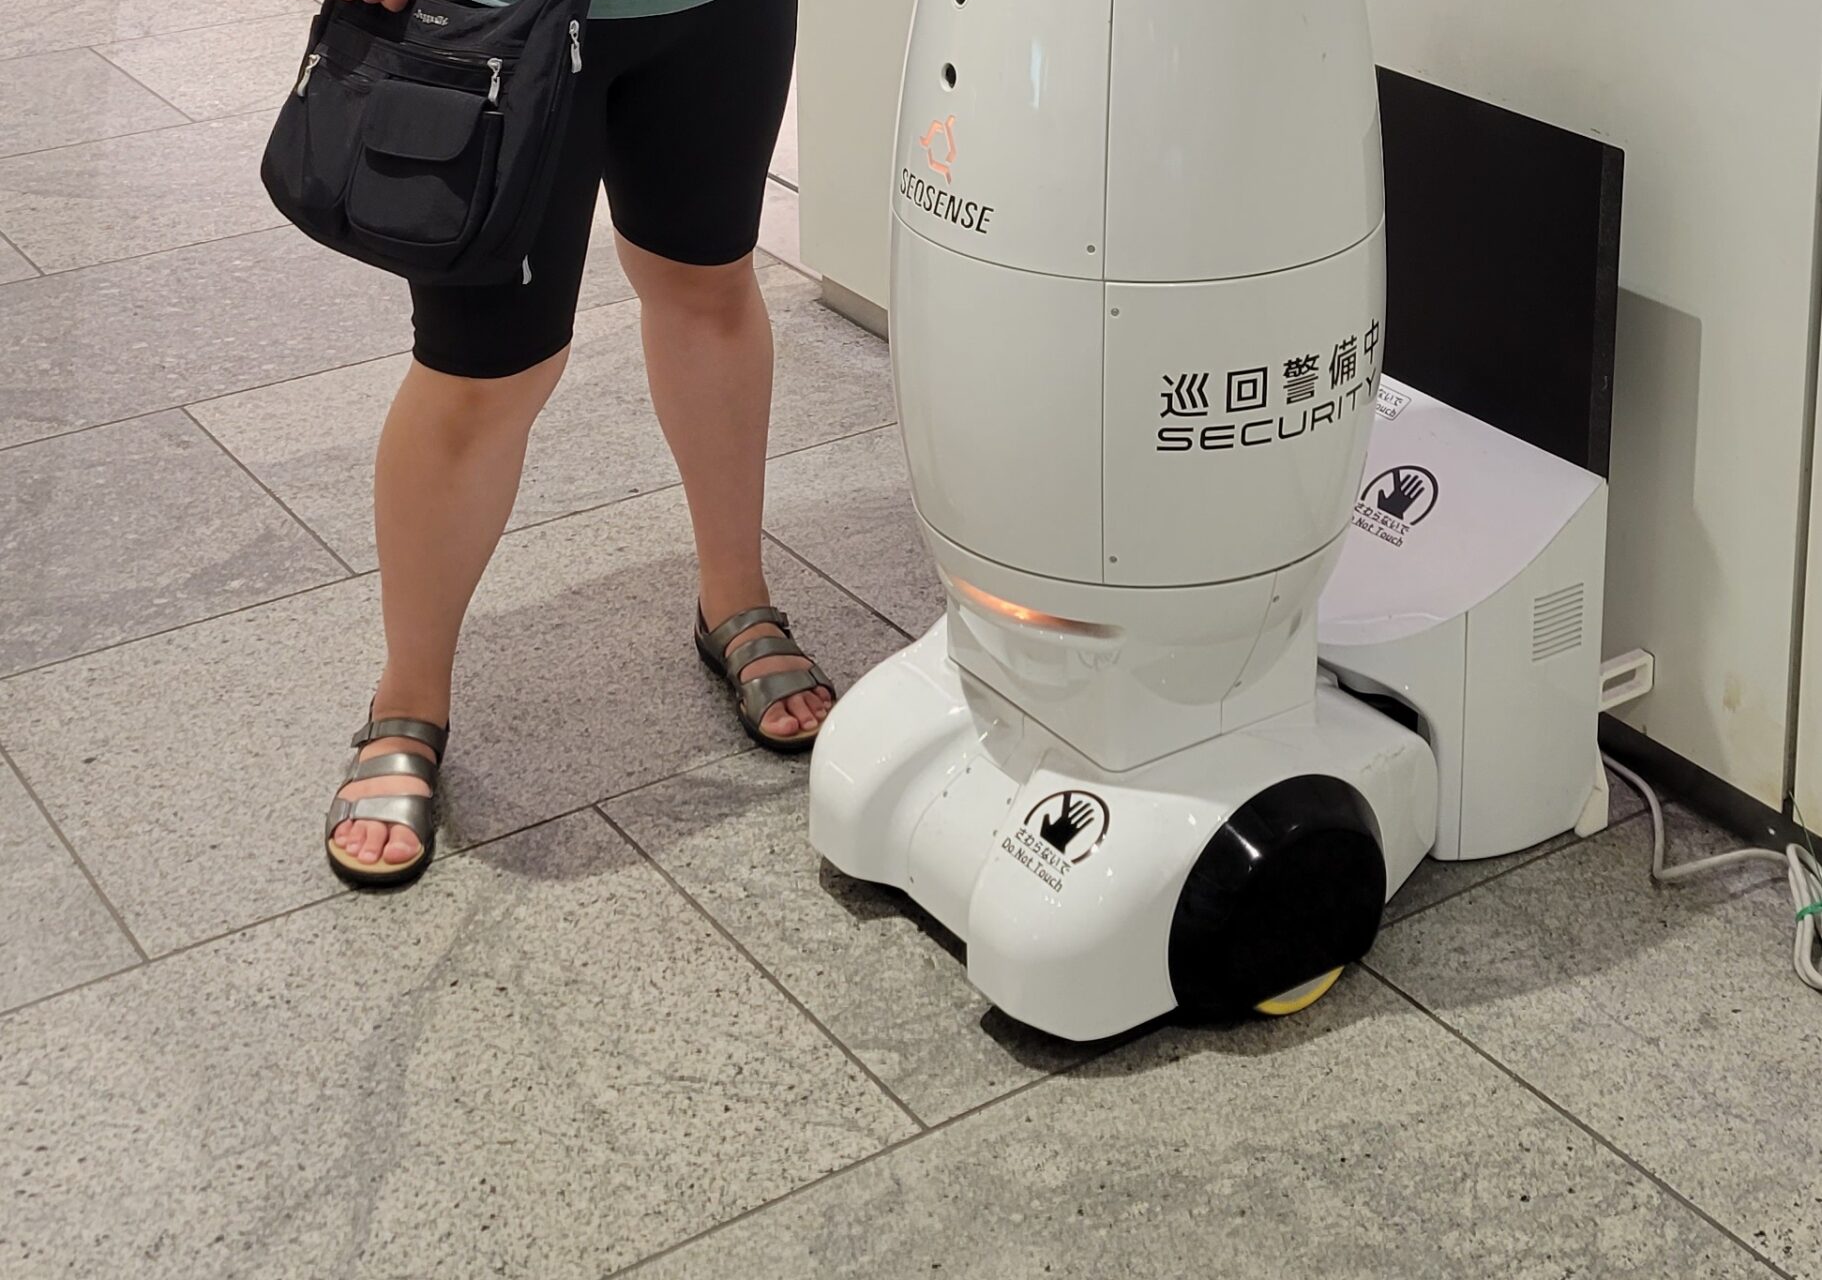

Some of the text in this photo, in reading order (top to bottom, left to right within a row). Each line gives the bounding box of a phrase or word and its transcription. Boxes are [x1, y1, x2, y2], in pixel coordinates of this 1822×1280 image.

[1160, 318, 1379, 418] 巡回警備中
[1157, 368, 1376, 451] SECURITY
[1376, 403, 1397, 417] ouch
[1354, 501, 1410, 535] さわらないで
[1357, 517, 1403, 547] Not Touch
[1001, 837, 1063, 893] Do Not Touch
[1015, 827, 1071, 875] さわらないで
